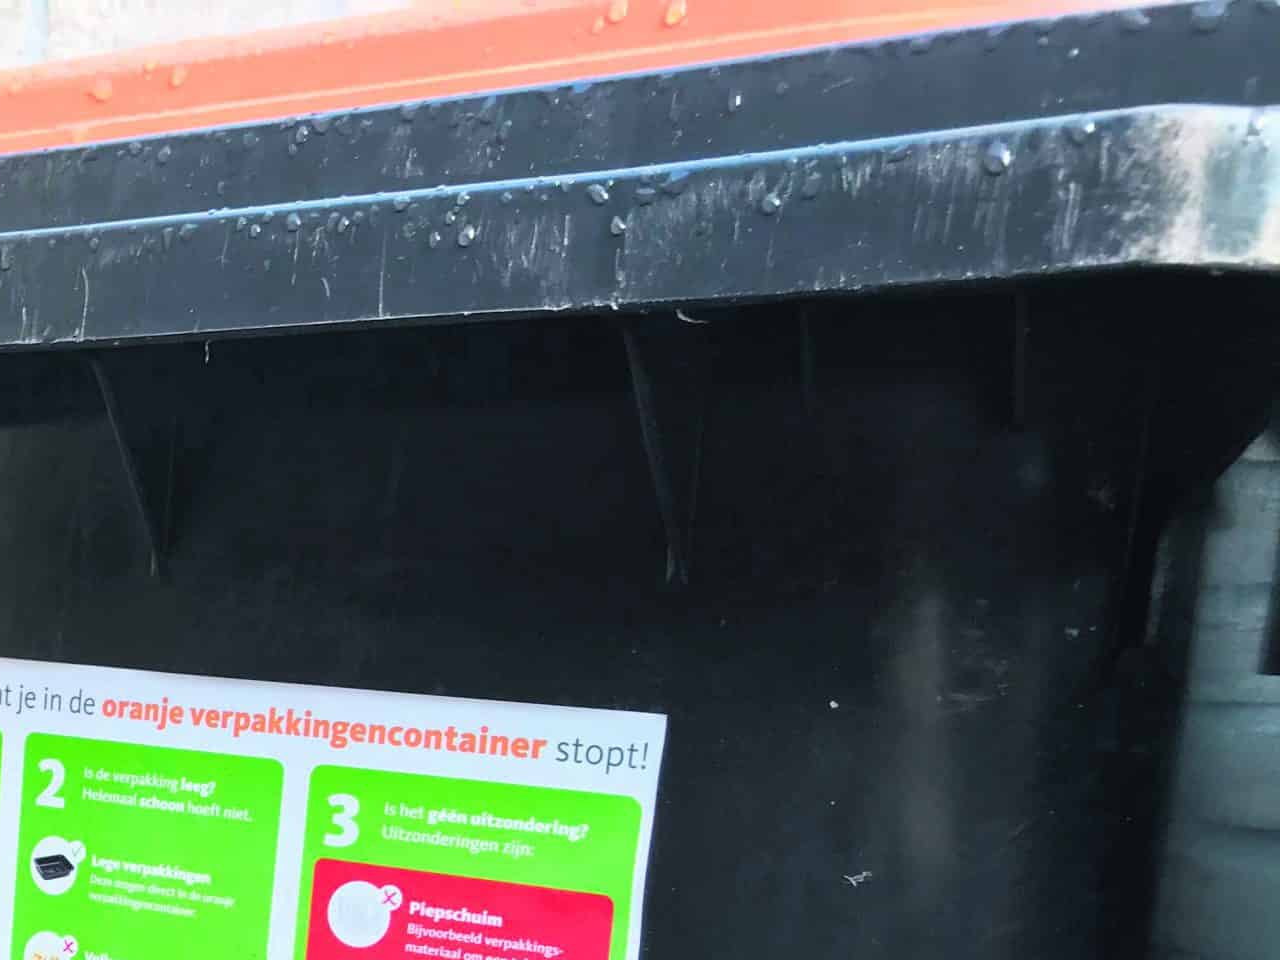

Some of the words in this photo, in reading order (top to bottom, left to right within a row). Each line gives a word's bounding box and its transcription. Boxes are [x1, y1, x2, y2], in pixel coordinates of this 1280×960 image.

[16, 684, 37, 715] je
[43, 687, 62, 712] in
[69, 689, 96, 715] de
[101, 696, 185, 731] oranje
[189, 706, 548, 759] verpakkingencontainer
[555, 737, 650, 775] stopt!
[34, 757, 66, 810] 2
[112, 771, 179, 793] verpakking
[139, 793, 185, 813] schoon
[322, 792, 361, 848] 3
[384, 802, 397, 817] Is
[400, 802, 425, 820] het
[471, 809, 590, 843] uitzondering?
[382, 825, 499, 854] Uitzonderingen
[501, 840, 536, 860] zijn:
[409, 900, 504, 928] Piepschuim
[407, 922, 483, 946] Bijvoorbeeld
[485, 935, 564, 959] verpakkings-
